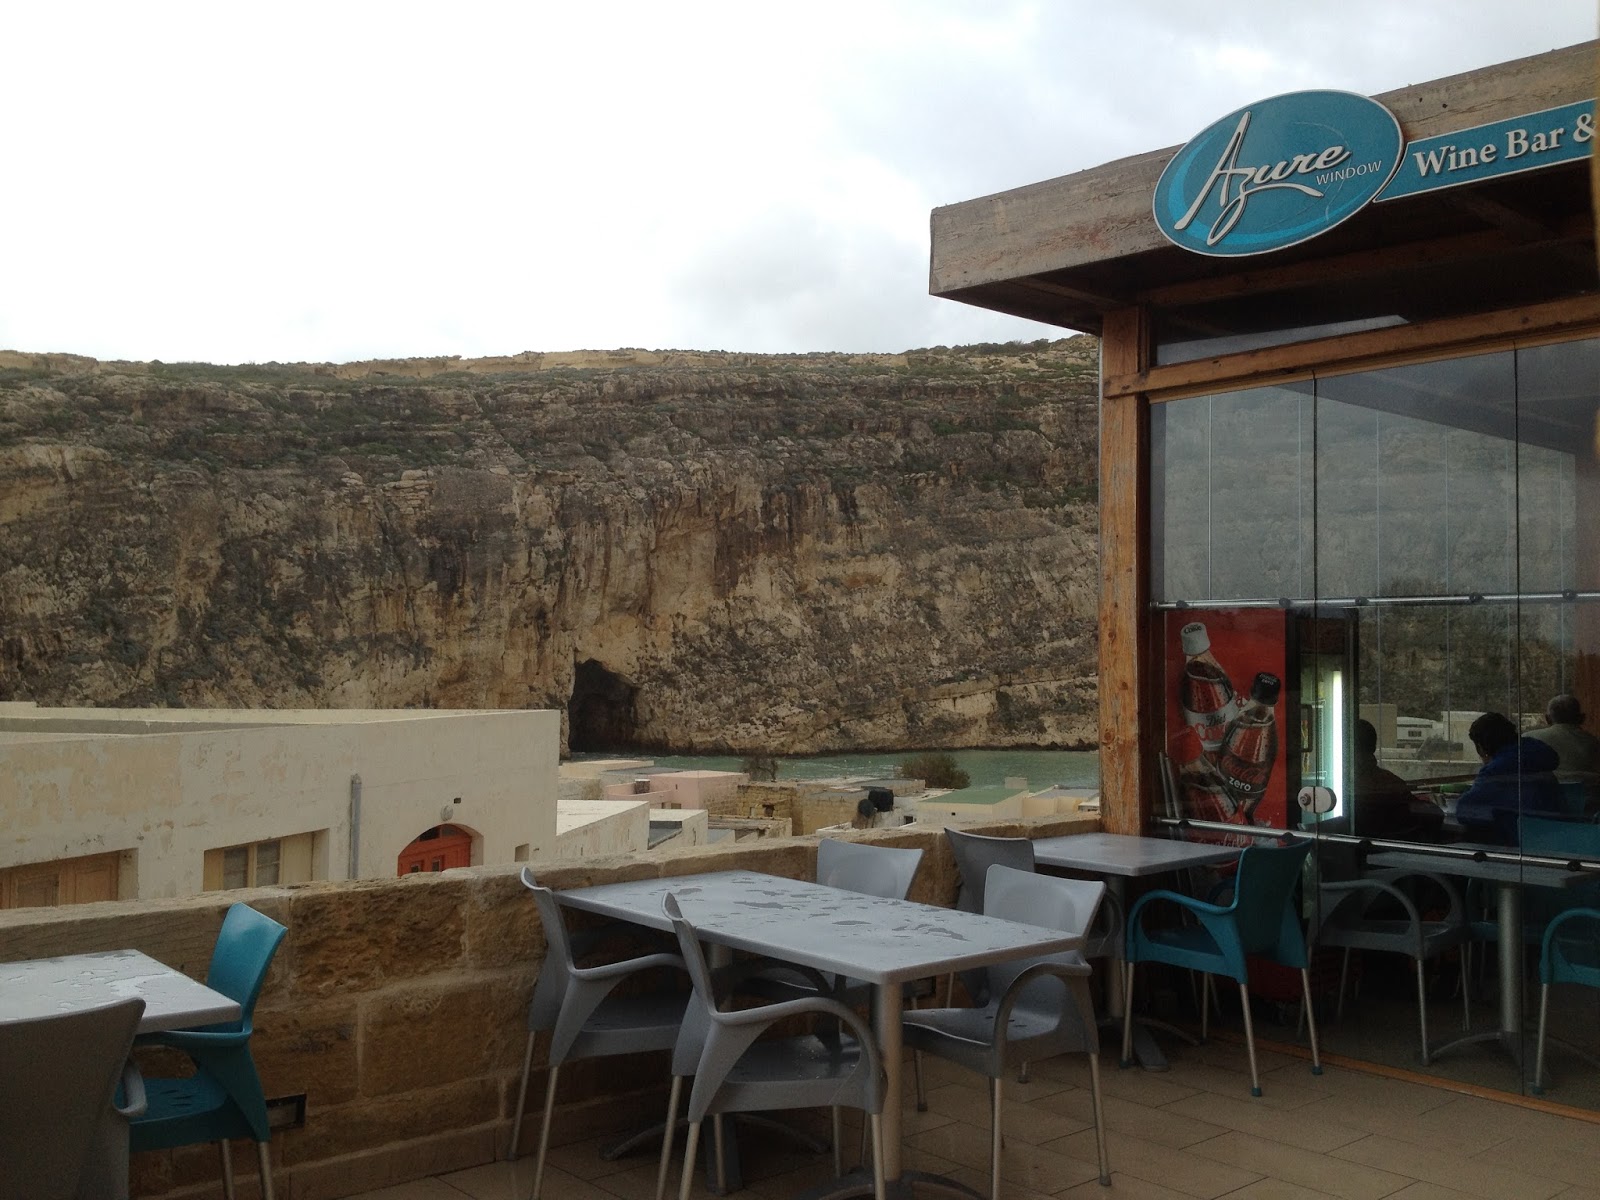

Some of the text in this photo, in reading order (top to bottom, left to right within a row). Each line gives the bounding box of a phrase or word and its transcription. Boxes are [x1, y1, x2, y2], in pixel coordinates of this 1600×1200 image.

[1413, 113, 1598, 177] Wine Bar &
[1174, 111, 1352, 246] Azure
[1316, 160, 1382, 186] WINDOW
[1229, 776, 1252, 792] zero
